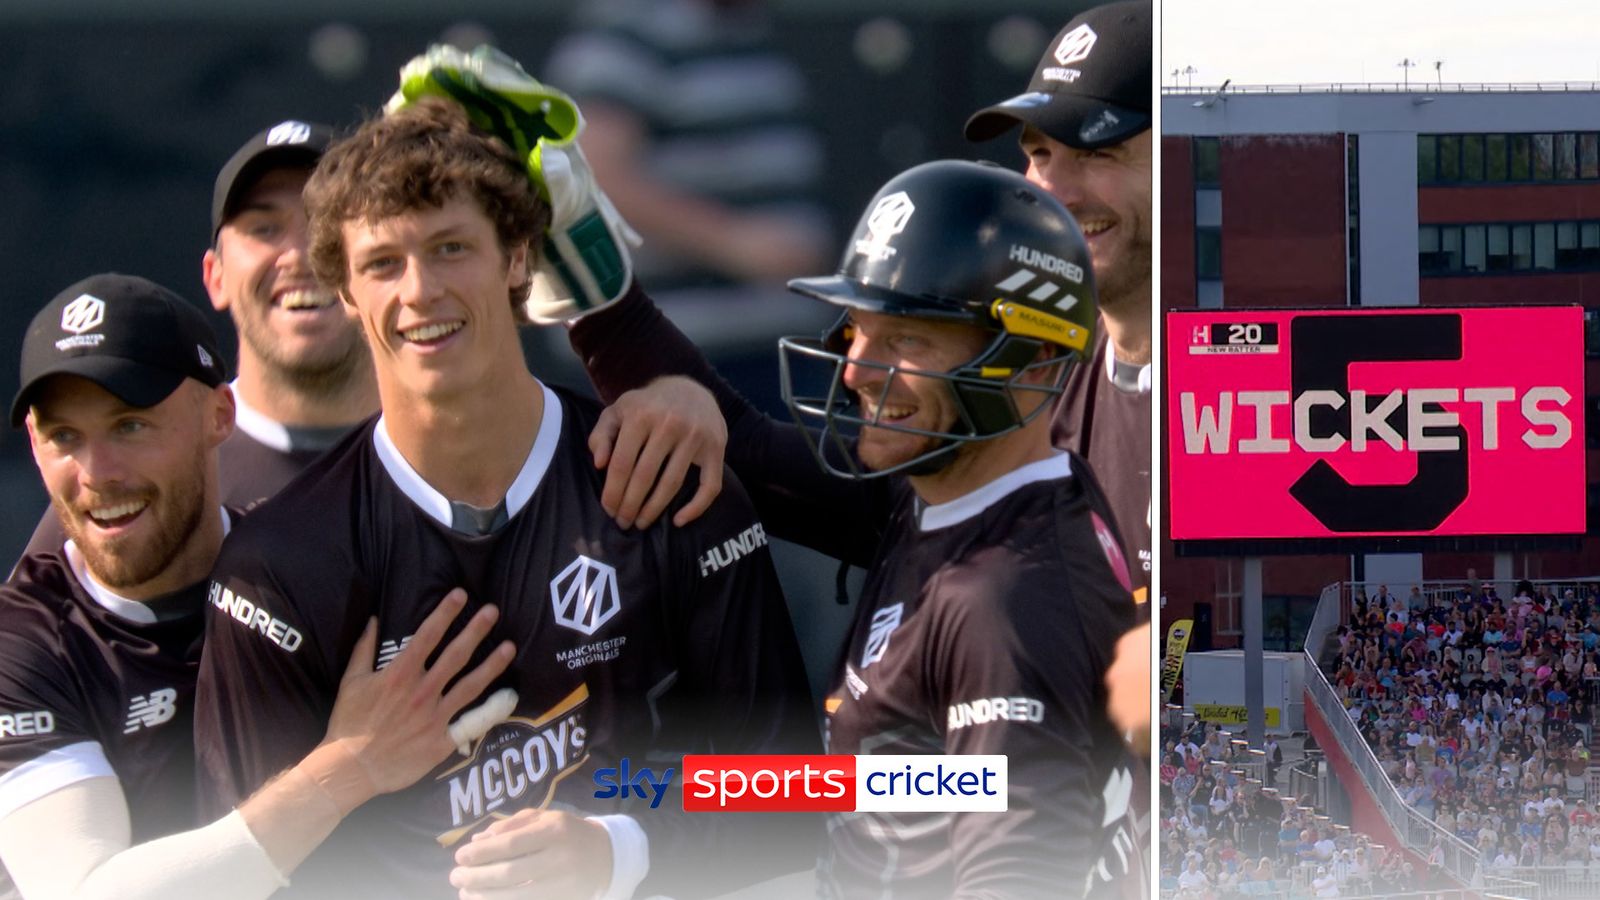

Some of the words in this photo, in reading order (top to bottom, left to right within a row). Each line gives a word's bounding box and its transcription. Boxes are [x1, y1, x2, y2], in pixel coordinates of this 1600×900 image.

[1009, 244, 1084, 284] HUNDRED
[1228, 324, 1261, 344] 20
[1180, 386, 1572, 455] WICKETS
[1289, 313, 1470, 532] 5
[208, 579, 303, 653] HUNDRED
[556, 636, 627, 662] MANCHESTER
[567, 648, 620, 670] ORIGINALS
